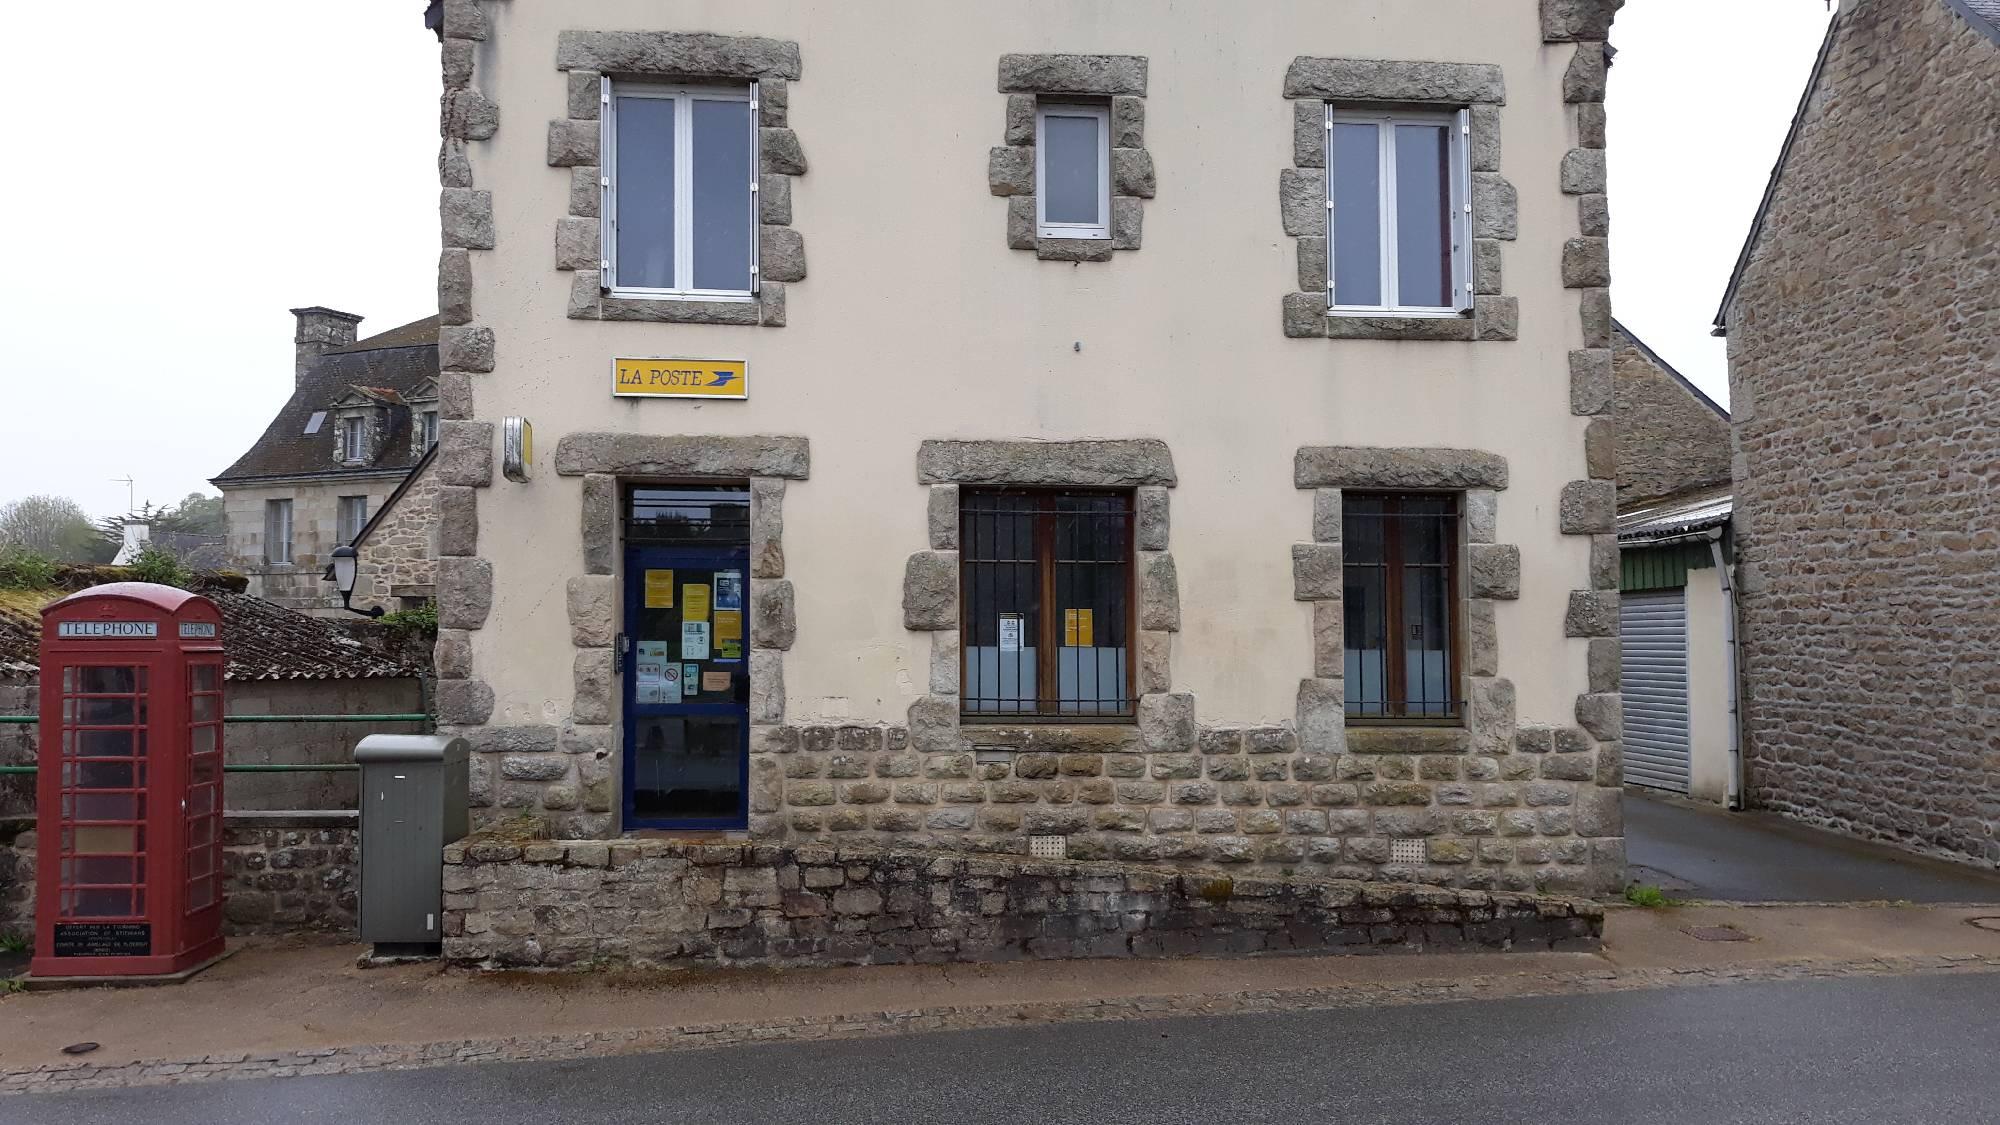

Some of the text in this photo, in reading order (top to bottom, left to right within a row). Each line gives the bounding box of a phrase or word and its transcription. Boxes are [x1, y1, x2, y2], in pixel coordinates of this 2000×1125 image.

[619, 368, 703, 386] LA POSTE
[64, 622, 154, 635] TELEPHONE
[182, 623, 213, 635] TELEPHONE
